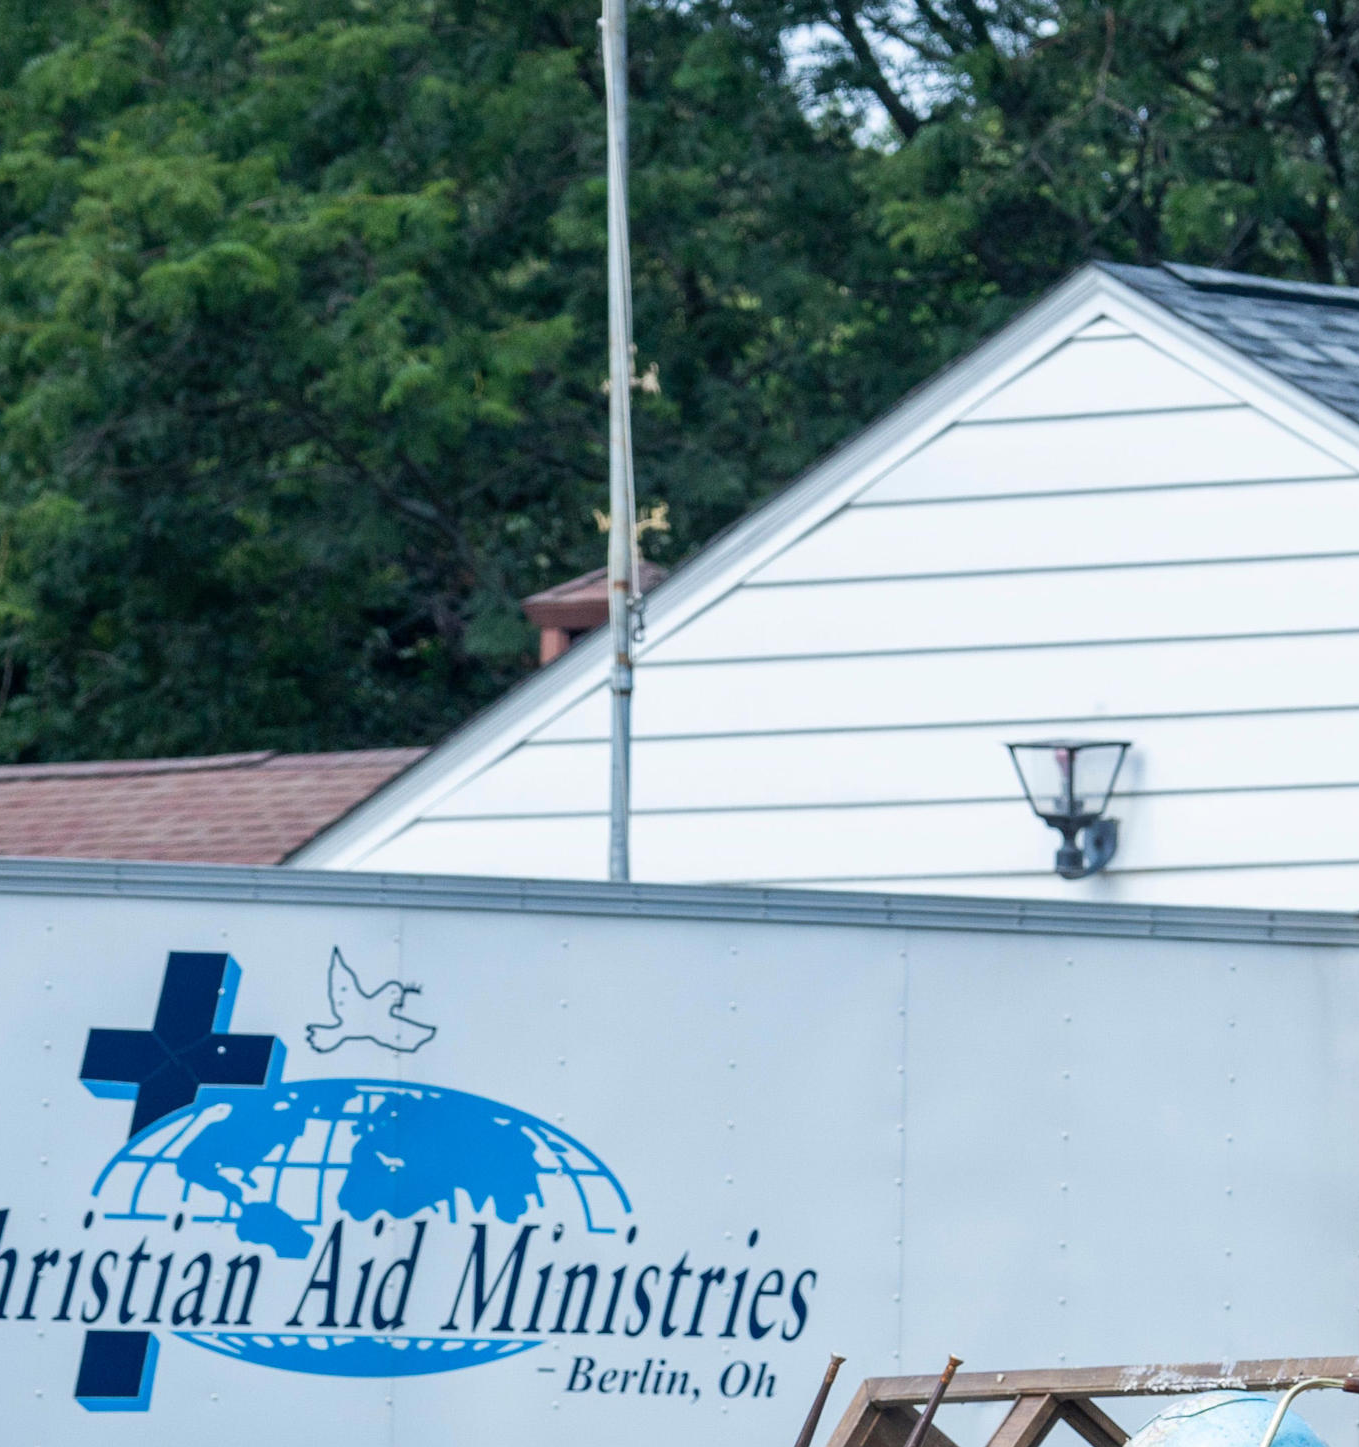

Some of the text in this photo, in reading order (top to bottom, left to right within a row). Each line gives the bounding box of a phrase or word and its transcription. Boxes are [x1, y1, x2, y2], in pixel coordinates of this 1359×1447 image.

[284, 1217, 428, 1332] Aid
[439, 1223, 819, 1342] Ministries
[718, 1360, 777, 1399] Oh
